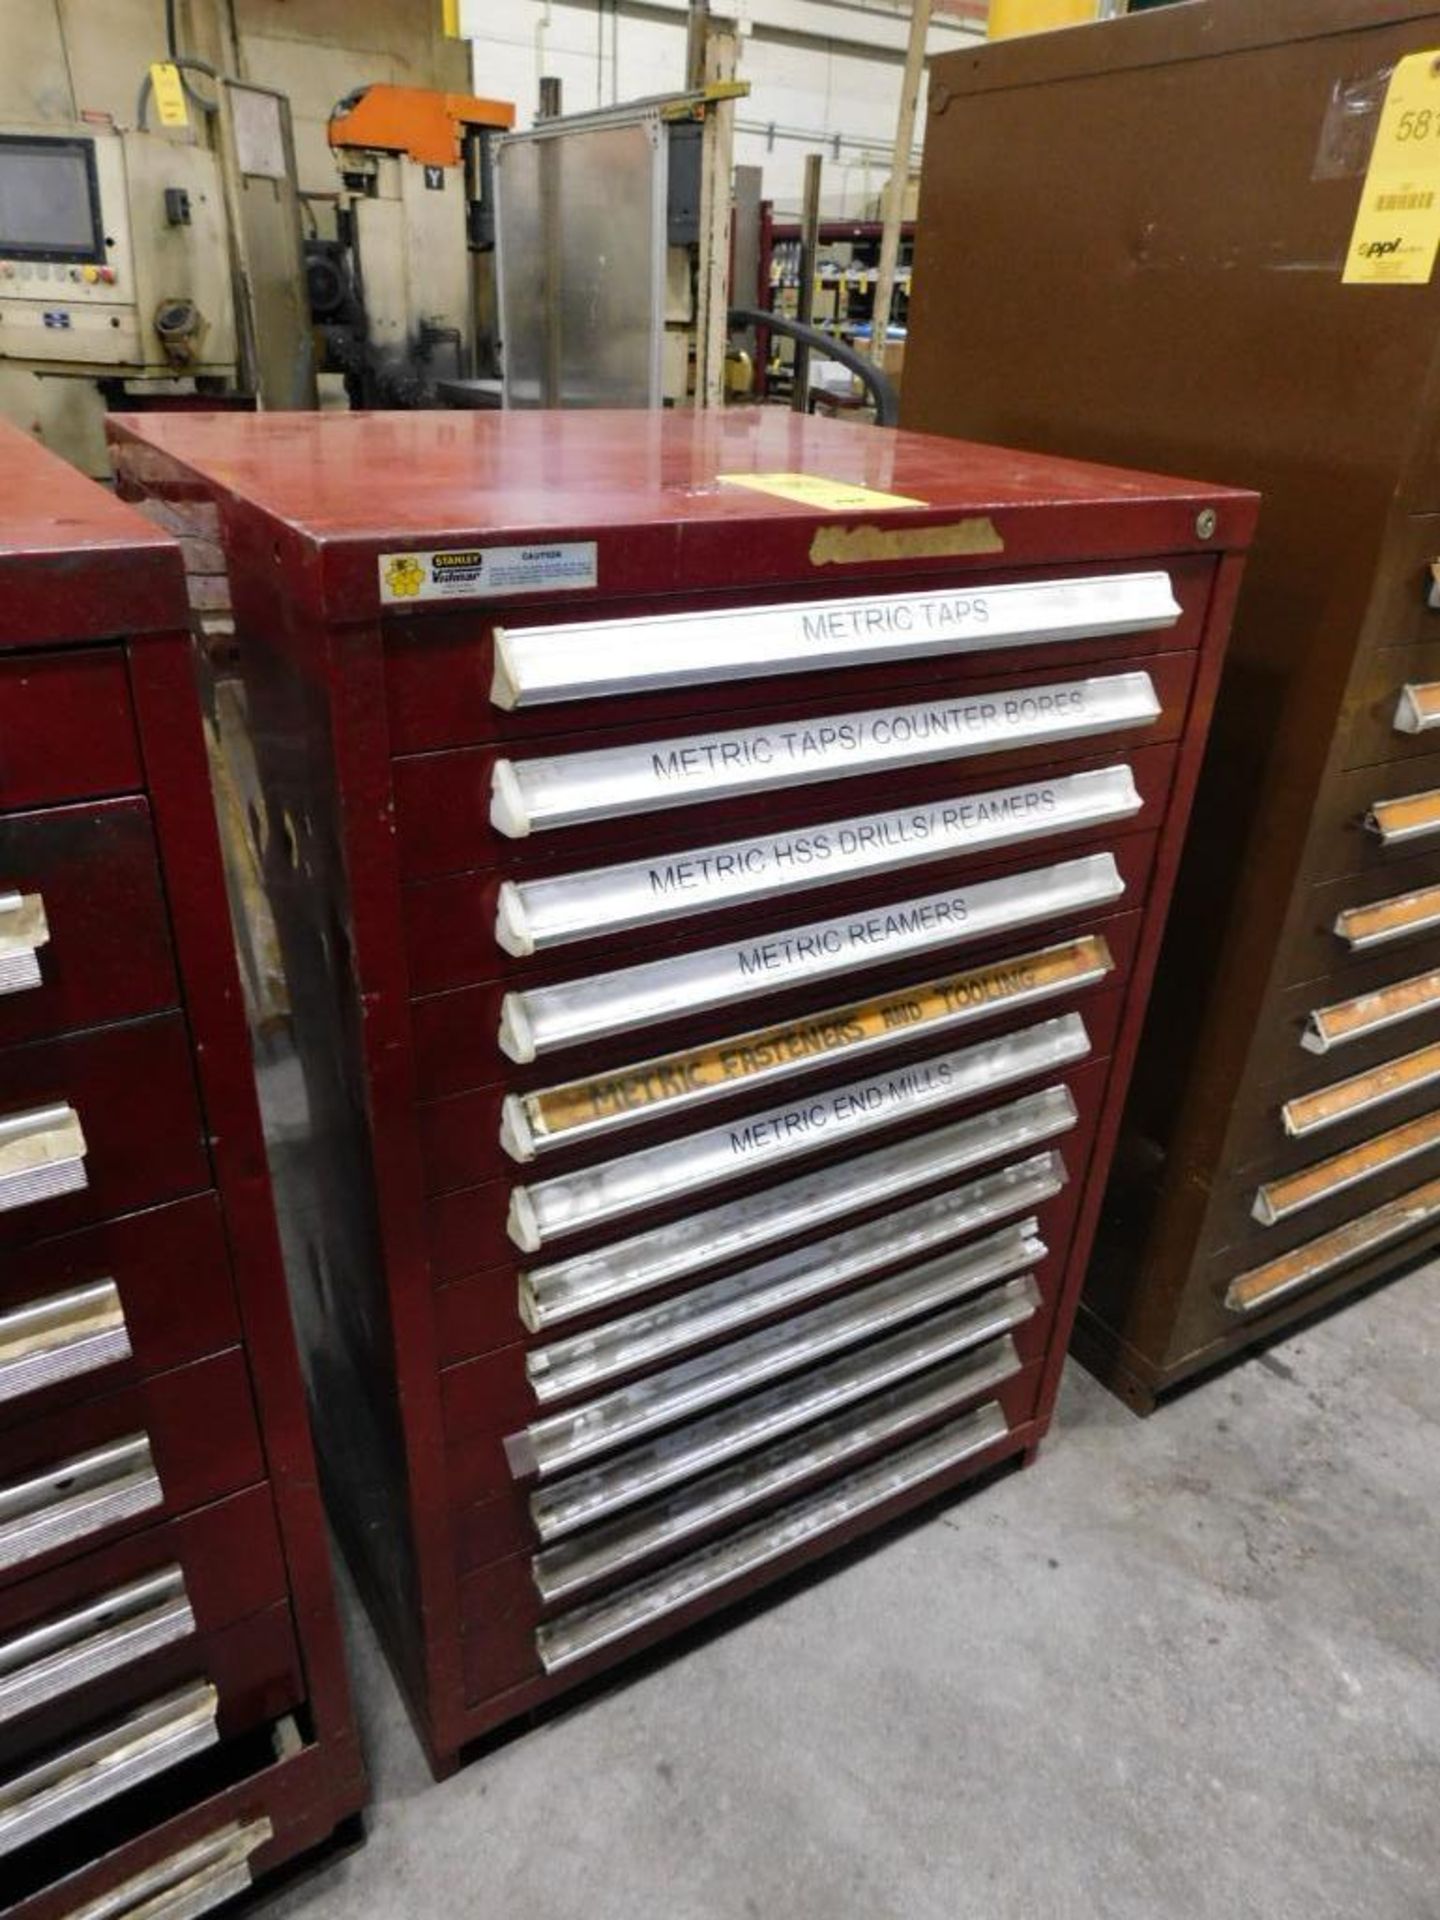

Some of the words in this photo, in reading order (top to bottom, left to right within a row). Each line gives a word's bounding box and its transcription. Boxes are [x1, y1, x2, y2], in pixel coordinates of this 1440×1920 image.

[427, 168, 441, 187] Y
[434, 554, 480, 566] STANLEY
[802, 606, 913, 642] METRIC
[919, 599, 989, 628] TAPS
[652, 737, 773, 781] METRIC
[780, 723, 863, 759] TAPS/
[872, 704, 997, 747] COUNTER
[1005, 691, 1086, 723] BORES
[649, 849, 766, 892] METRIC
[774, 837, 832, 868] HSS
[839, 814, 935, 855] DRILLS/
[942, 790, 1056, 828] REAMERS
[738, 930, 841, 974] METRIC
[848, 899, 968, 945] REAMERS
[591, 1062, 706, 1113] METRIC
[719, 1017, 864, 1078] FASTENERS
[881, 1002, 923, 1028] AND
[934, 967, 1036, 1014] TOOLING
[730, 1105, 828, 1154] METRIC
[833, 1087, 882, 1121] END
[889, 1063, 954, 1099] MILLS
